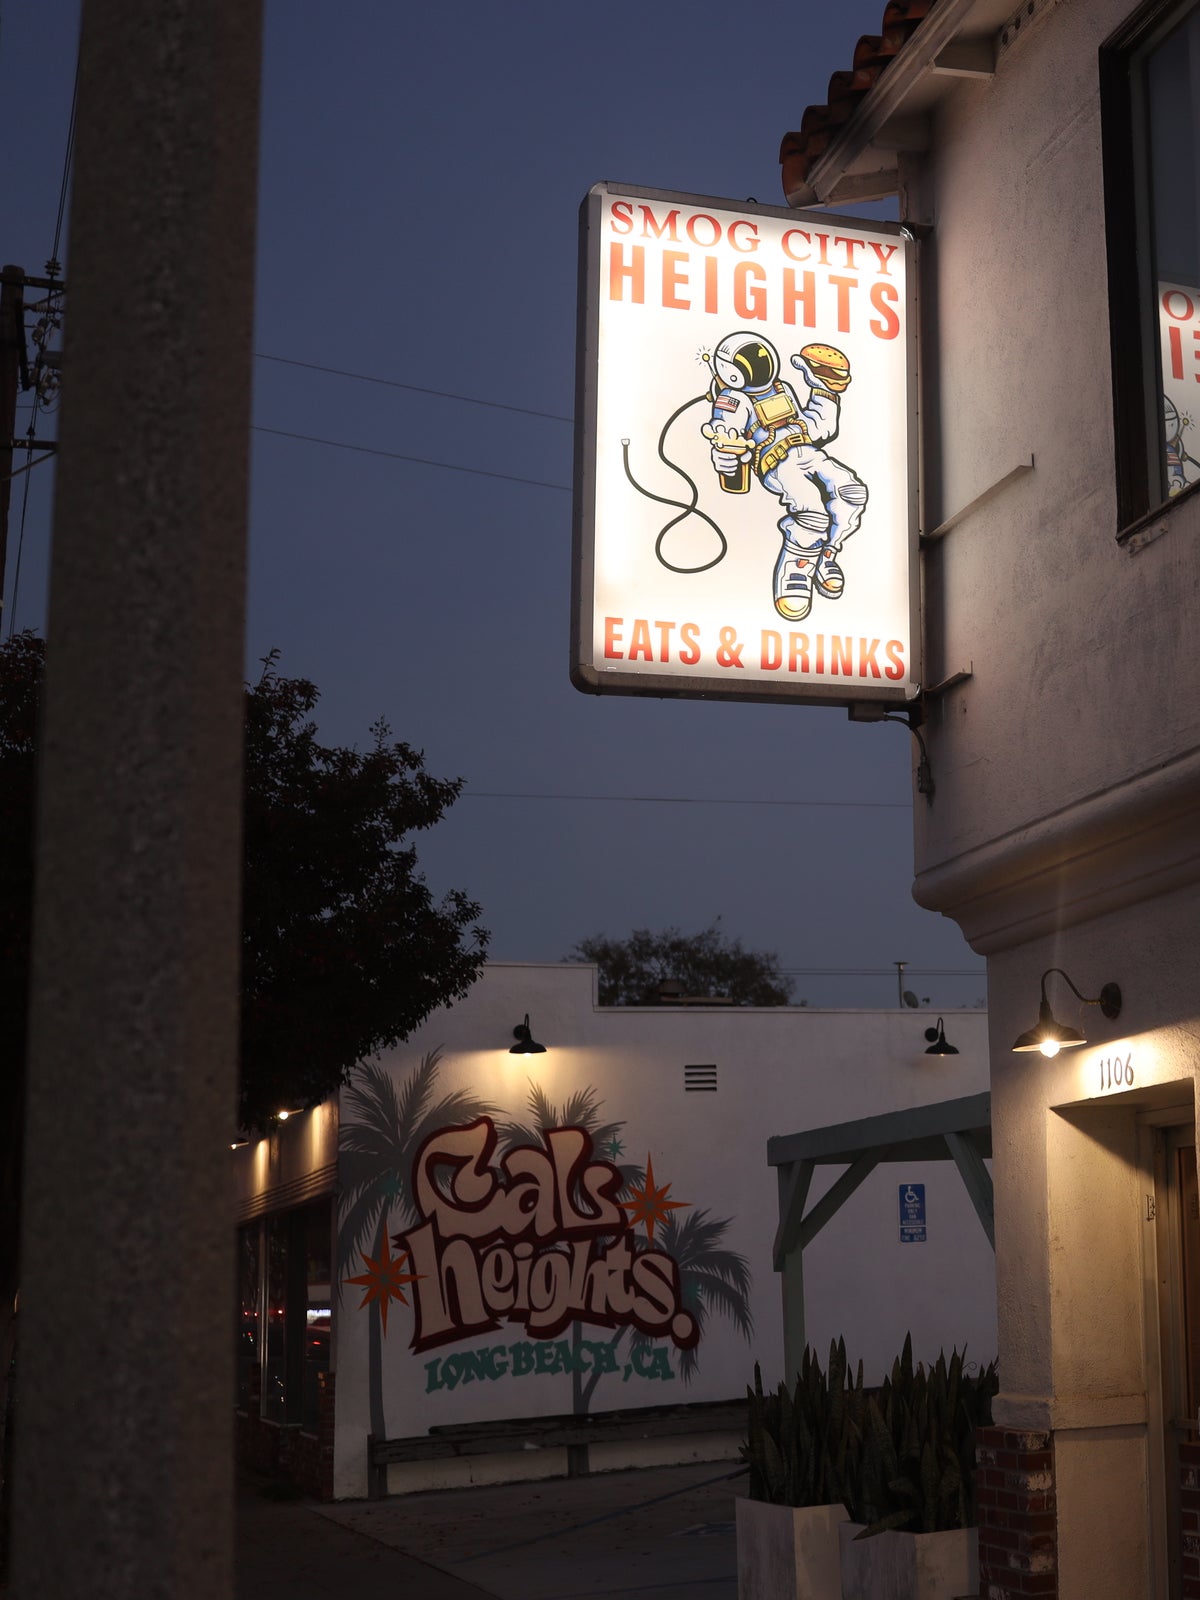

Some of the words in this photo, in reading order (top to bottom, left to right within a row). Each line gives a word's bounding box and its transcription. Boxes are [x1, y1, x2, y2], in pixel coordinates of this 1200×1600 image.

[610, 200, 761, 253] SMOG
[781, 229, 899, 276] CITY
[609, 241, 901, 341] HEIGHTS
[603, 617, 701, 665] EATS
[716, 625, 745, 669] &
[760, 630, 906, 681] DRINKS
[1100, 1053, 1134, 1090] 1106
[424, 1345, 509, 1394] LONG
